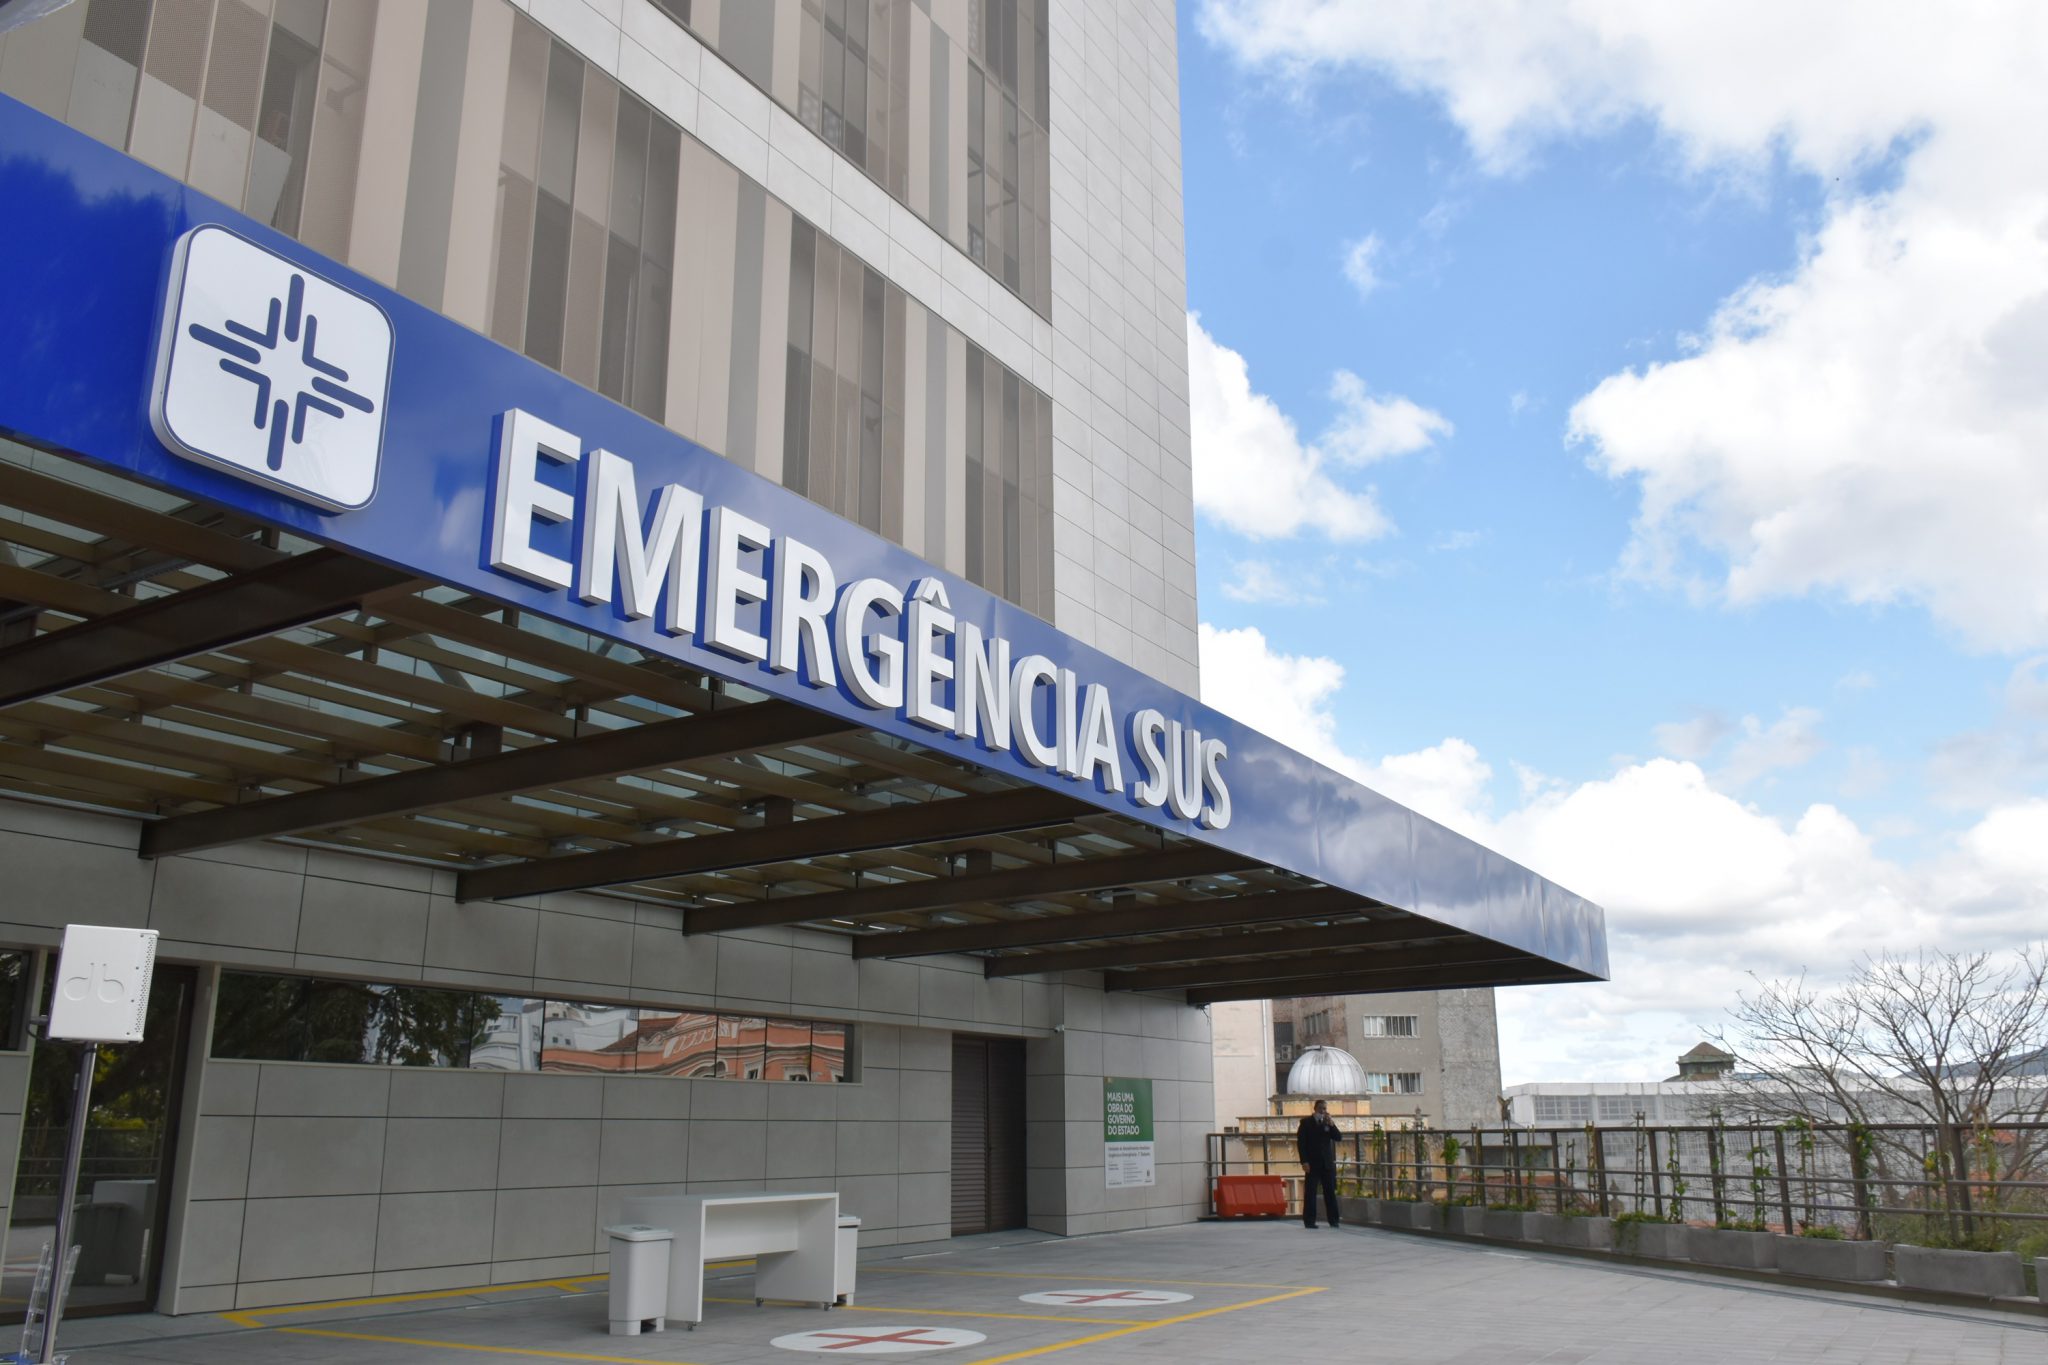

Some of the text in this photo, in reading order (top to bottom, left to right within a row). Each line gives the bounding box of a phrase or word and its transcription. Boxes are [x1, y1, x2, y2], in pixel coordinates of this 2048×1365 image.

[490, 407, 1232, 830] EMERGÊNCIA SUS
[1107, 1092, 1135, 1102] MAIS UMA
[1107, 1103, 1133, 1113] OBRA DO
[1107, 1114, 1136, 1124] GOVERNO
[1107, 1125, 1140, 1135] DO ESTADO
